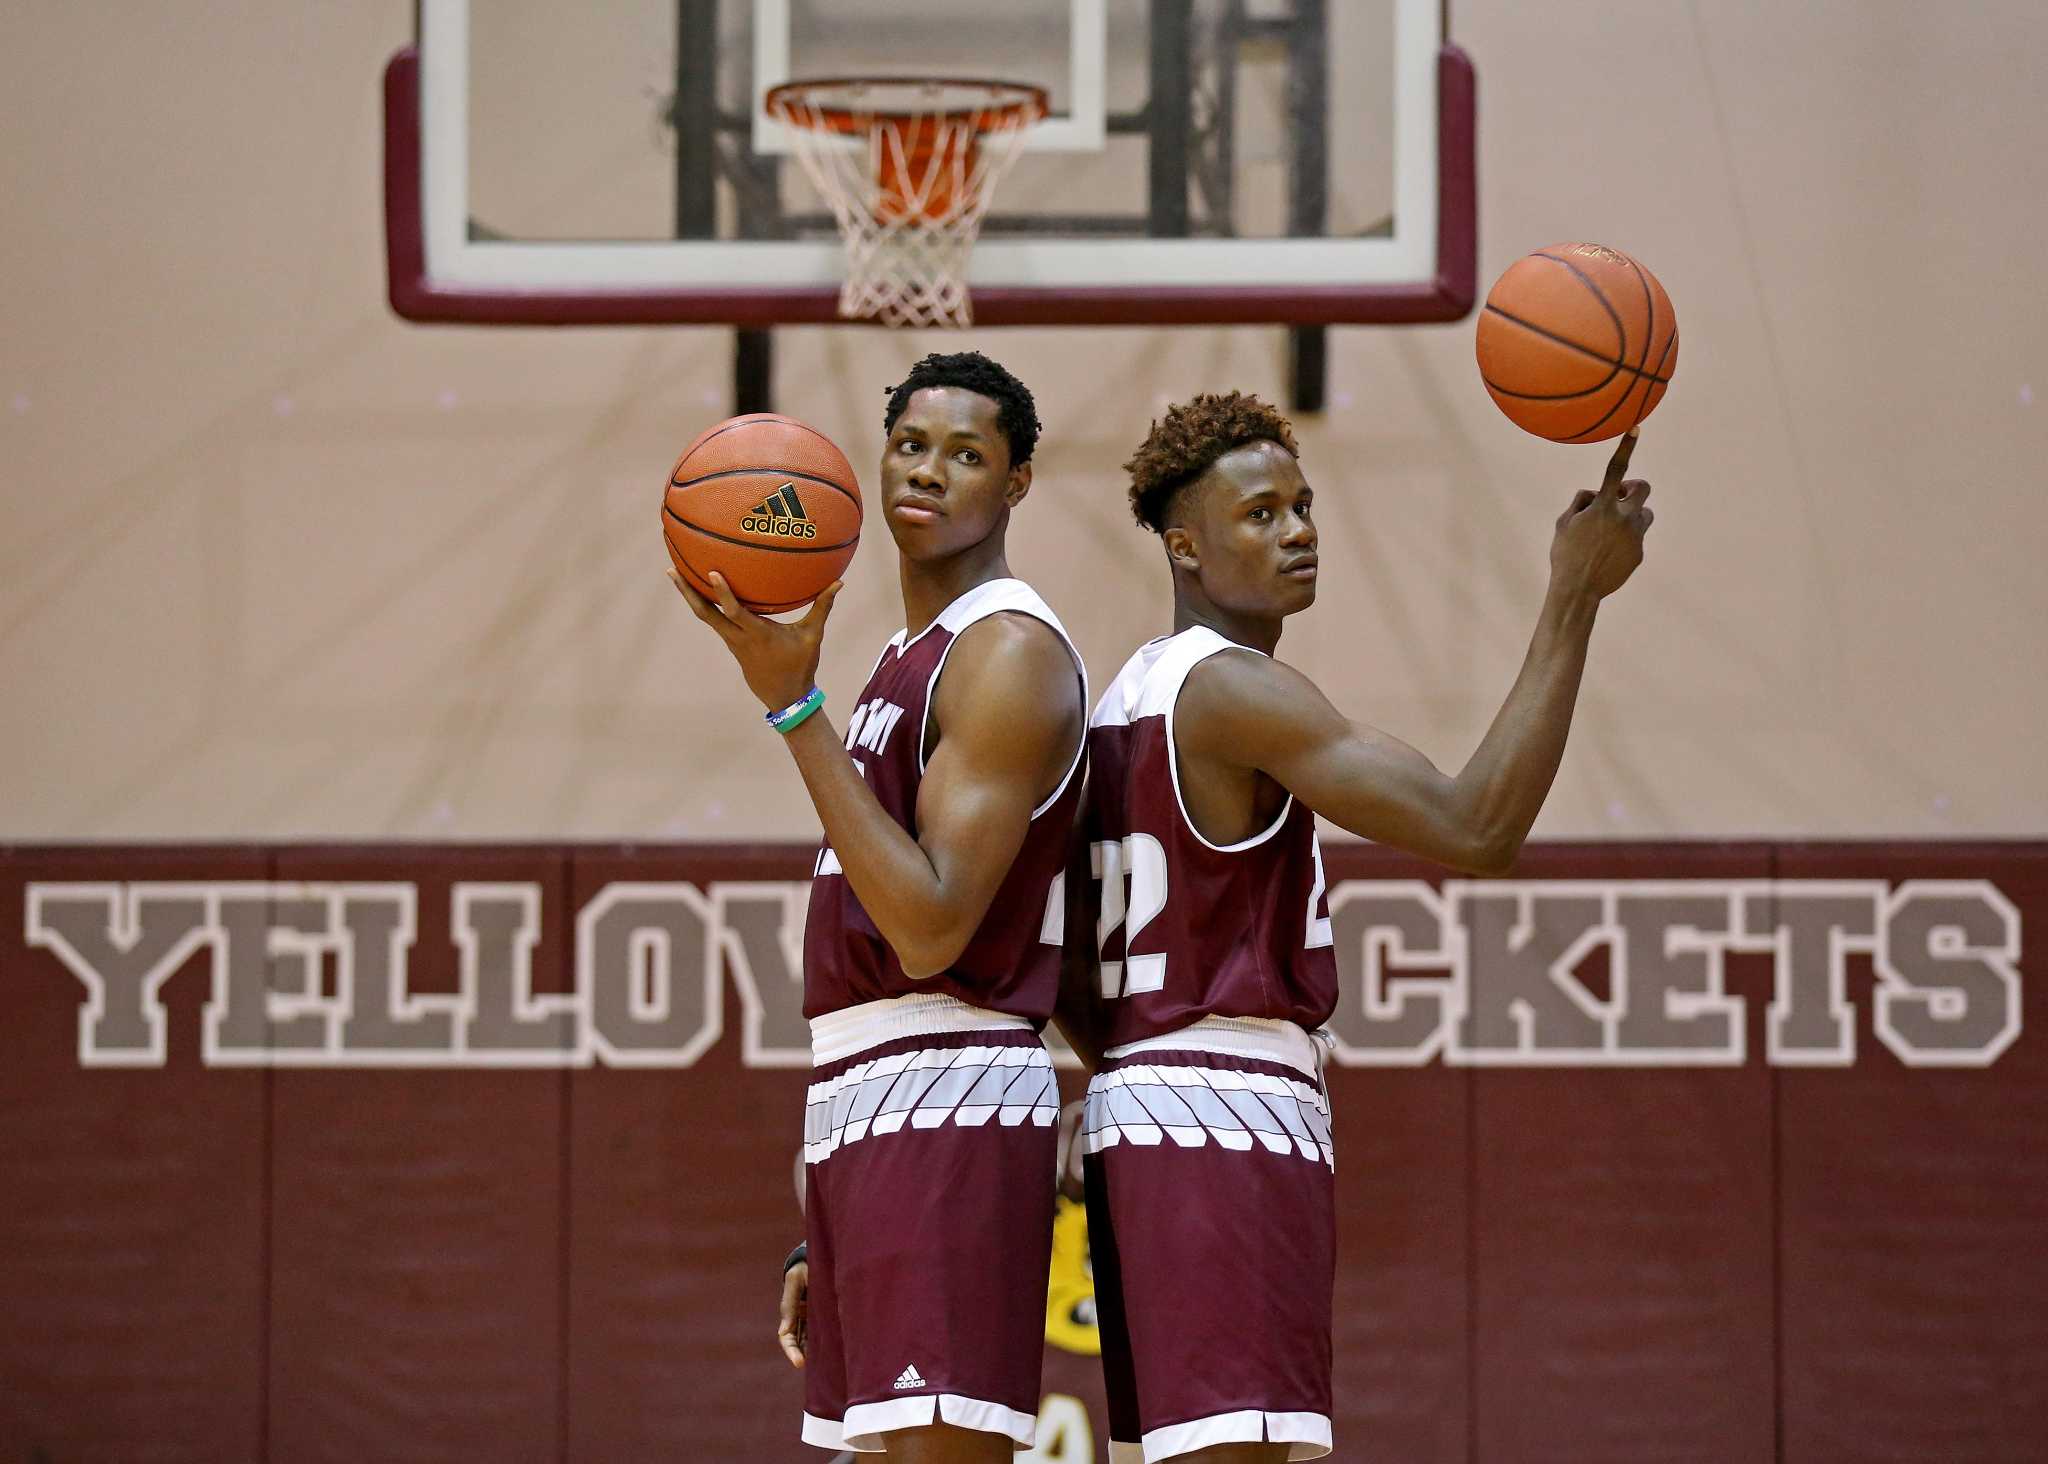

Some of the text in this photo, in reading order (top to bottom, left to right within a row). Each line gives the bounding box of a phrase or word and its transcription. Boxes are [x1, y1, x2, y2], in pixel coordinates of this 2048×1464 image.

[741, 515, 817, 539] adidas
[1326, 879, 2021, 1067] CKETS
[893, 1379, 926, 1389] adidas
